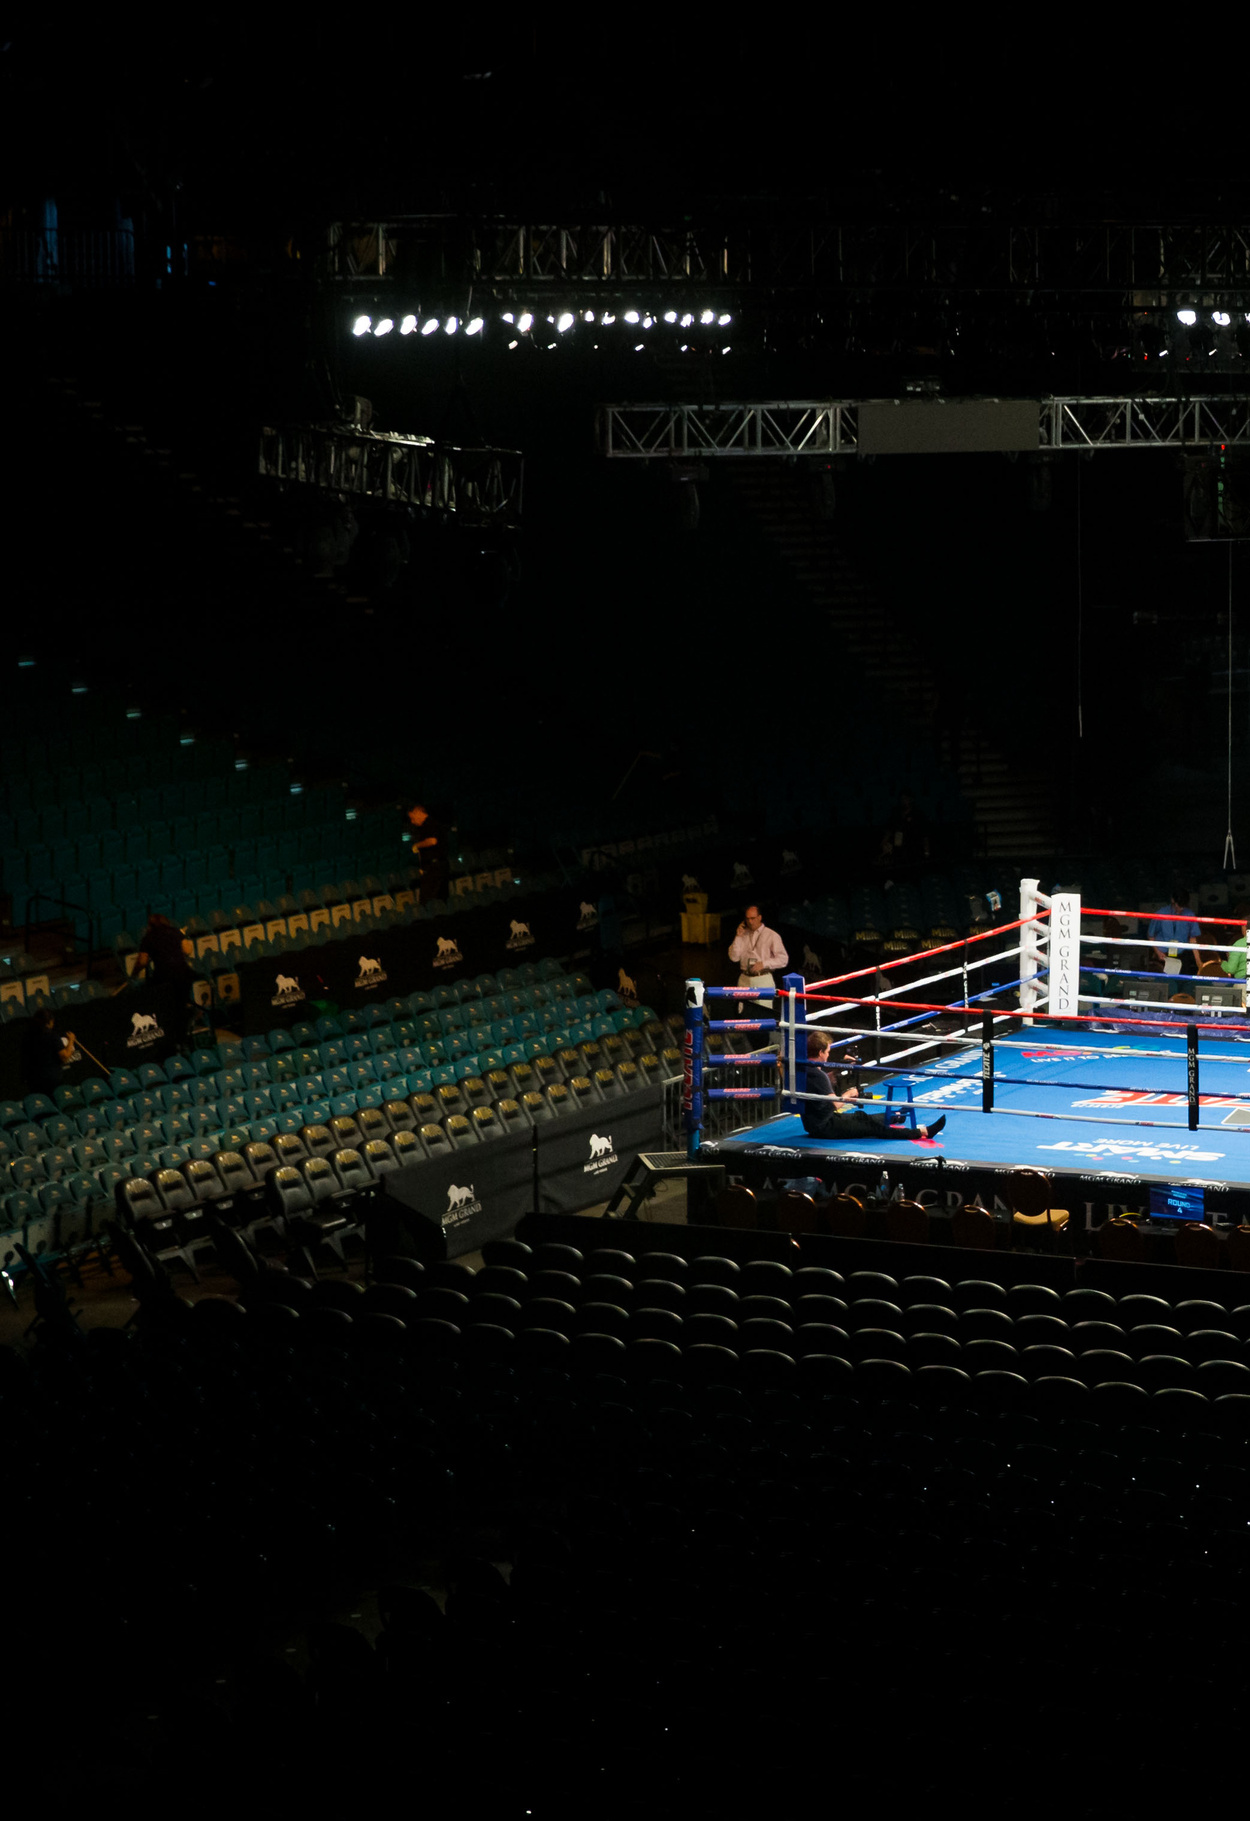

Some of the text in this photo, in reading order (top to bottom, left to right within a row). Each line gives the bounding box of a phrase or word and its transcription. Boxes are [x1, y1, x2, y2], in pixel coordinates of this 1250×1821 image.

[1057, 901, 1072, 1010] MGM GRAND
[983, 1051, 992, 1080] TECATE
[1187, 1048, 1197, 1103] MGM GRAND
[1036, 1141, 1226, 1162] SMART
[1092, 1138, 1200, 1151] LIVE MORE
[1167, 1198, 1191, 1209] ROUND
[1177, 1206, 1183, 1214] 4
